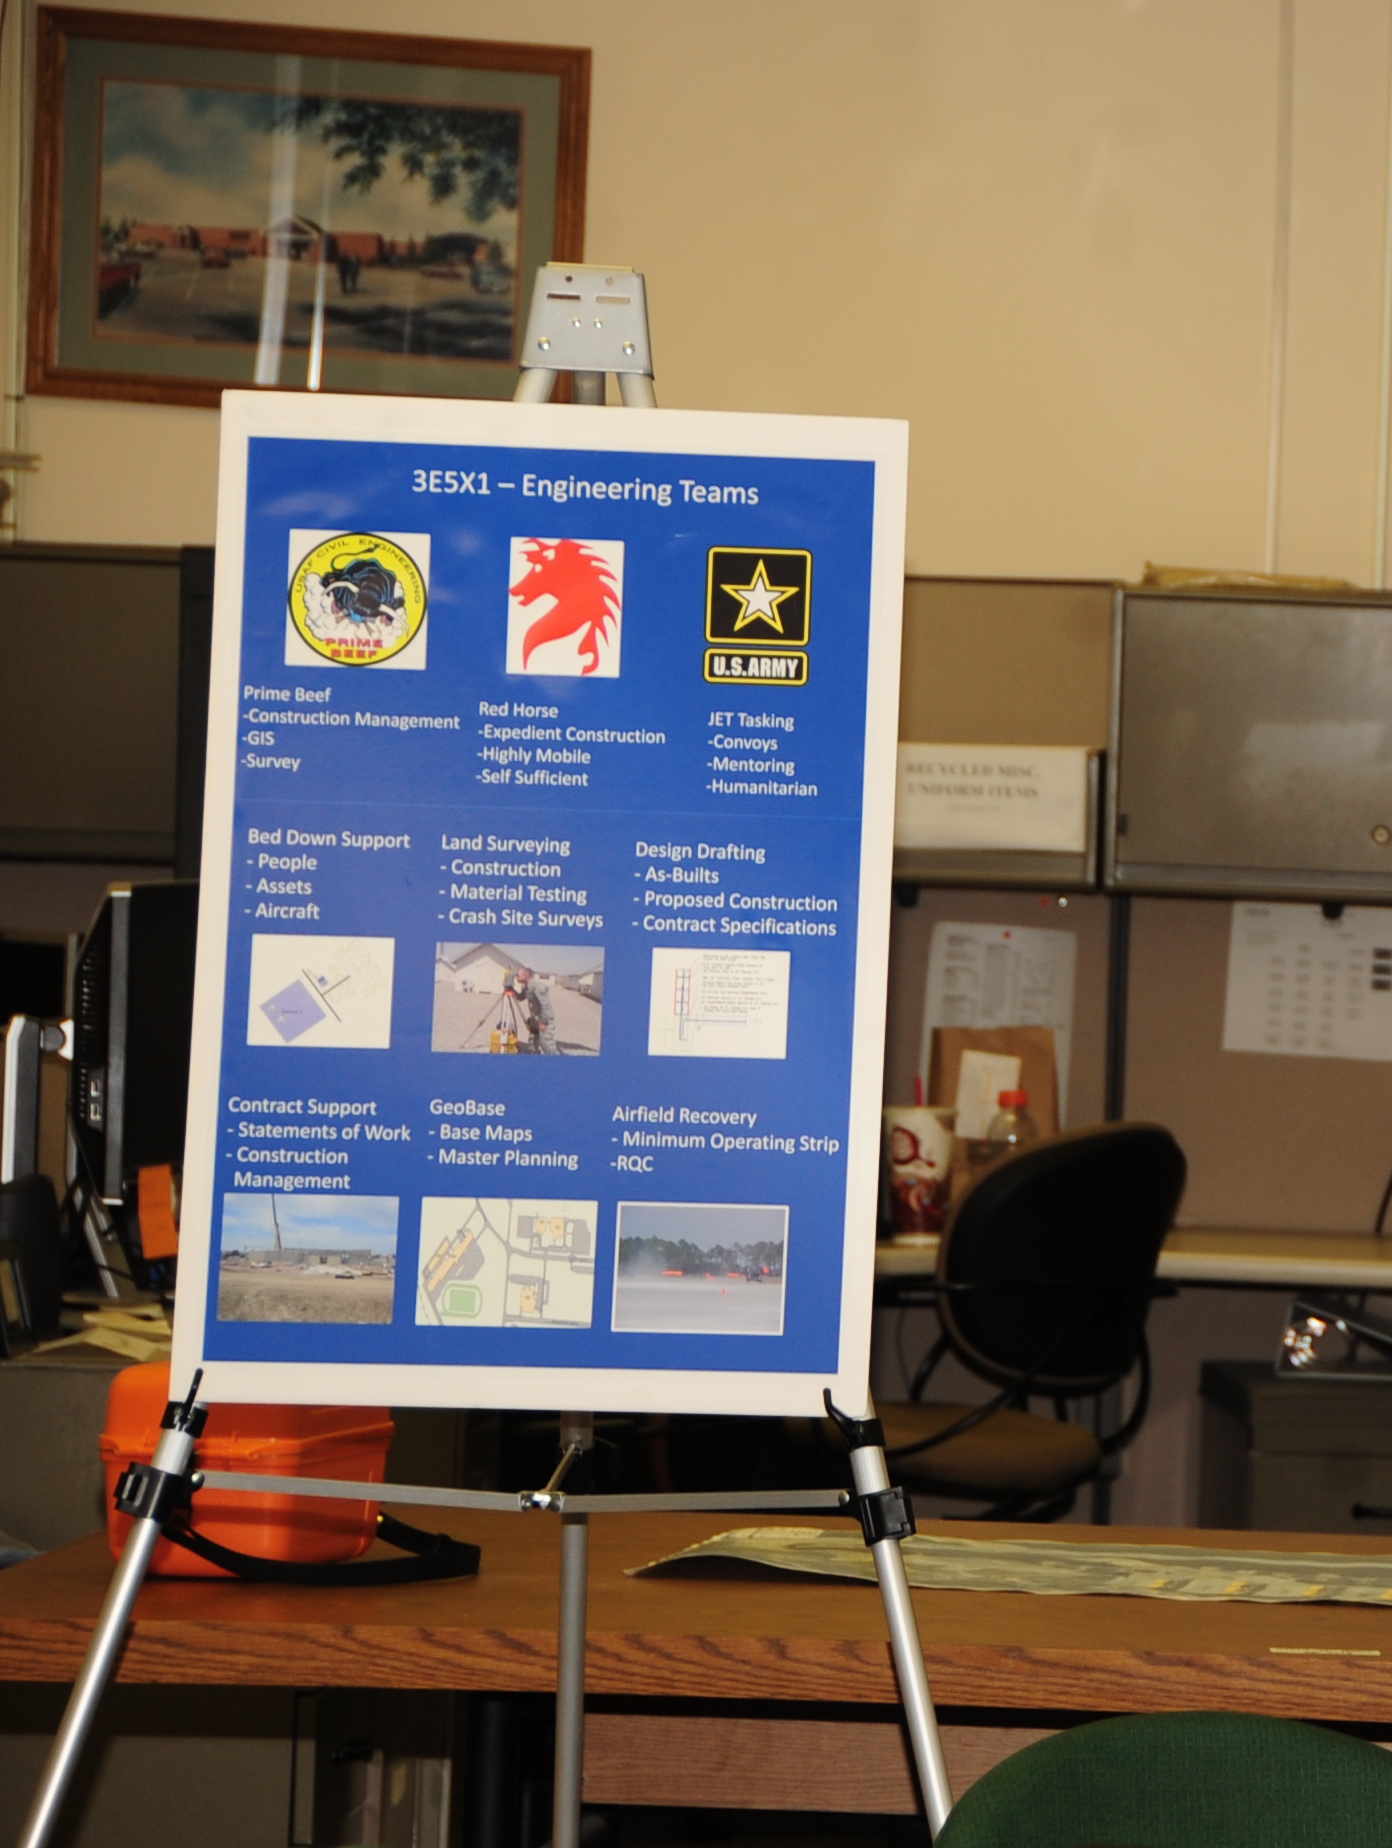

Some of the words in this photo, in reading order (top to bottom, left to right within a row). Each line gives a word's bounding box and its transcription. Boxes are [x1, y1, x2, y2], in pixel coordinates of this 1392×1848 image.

[412, 468, 491, 495] 3E5X1
[522, 472, 673, 507] Engineering
[678, 478, 760, 505] Teams
[296, 560, 313, 593] USAF
[316, 539, 350, 559] CIVIL
[358, 538, 421, 604] ENGINEERING
[325, 637, 384, 649] PRIME
[330, 648, 378, 660] BEEF
[242, 684, 292, 702] Prime
[294, 686, 332, 703] Beef
[478, 700, 510, 717] Red
[513, 702, 559, 719] Horse
[354, 710, 461, 731] Management
[707, 710, 735, 726] JET
[737, 711, 795, 732] Tasking
[565, 725, 666, 744] Construction
[535, 746, 592, 764] Mobile
[514, 768, 589, 787] Sufficient
[248, 827, 282, 844] Bed
[286, 828, 338, 847] Down
[341, 830, 411, 851] Support
[441, 833, 483, 851] Land
[486, 834, 571, 857] Surveying
[258, 852, 318, 873] People
[635, 840, 693, 863] Design
[697, 842, 766, 864] Drafting
[451, 858, 562, 878] Construction
[644, 864, 720, 884] As-Builts
[256, 877, 313, 895] Assets
[450, 882, 523, 901] Material
[526, 884, 588, 907] Testing
[254, 901, 321, 920] Aircraft
[644, 889, 725, 911] Proposed
[729, 891, 838, 912] Construction
[448, 906, 497, 925] Crash
[501, 907, 534, 926] Site
[537, 909, 604, 931] Surveys
[642, 914, 717, 933] Contract
[719, 915, 837, 937] Specifications
[227, 1095, 304, 1114] Contract
[307, 1096, 378, 1118] Support
[429, 1097, 506, 1116] GeoBase
[612, 1105, 675, 1123] Airfield
[679, 1106, 758, 1128] Recovery
[238, 1120, 338, 1139] Statements
[341, 1122, 362, 1140] of
[364, 1123, 411, 1141] Work
[439, 1122, 481, 1141] Base
[485, 1123, 533, 1145] Maps
[623, 1130, 706, 1148] Minimum
[710, 1132, 796, 1154] Operating
[799, 1133, 840, 1155] Strip
[236, 1145, 349, 1165] Construction
[438, 1148, 501, 1166] Master
[504, 1148, 579, 1170] Planning
[233, 1170, 351, 1192] Management
